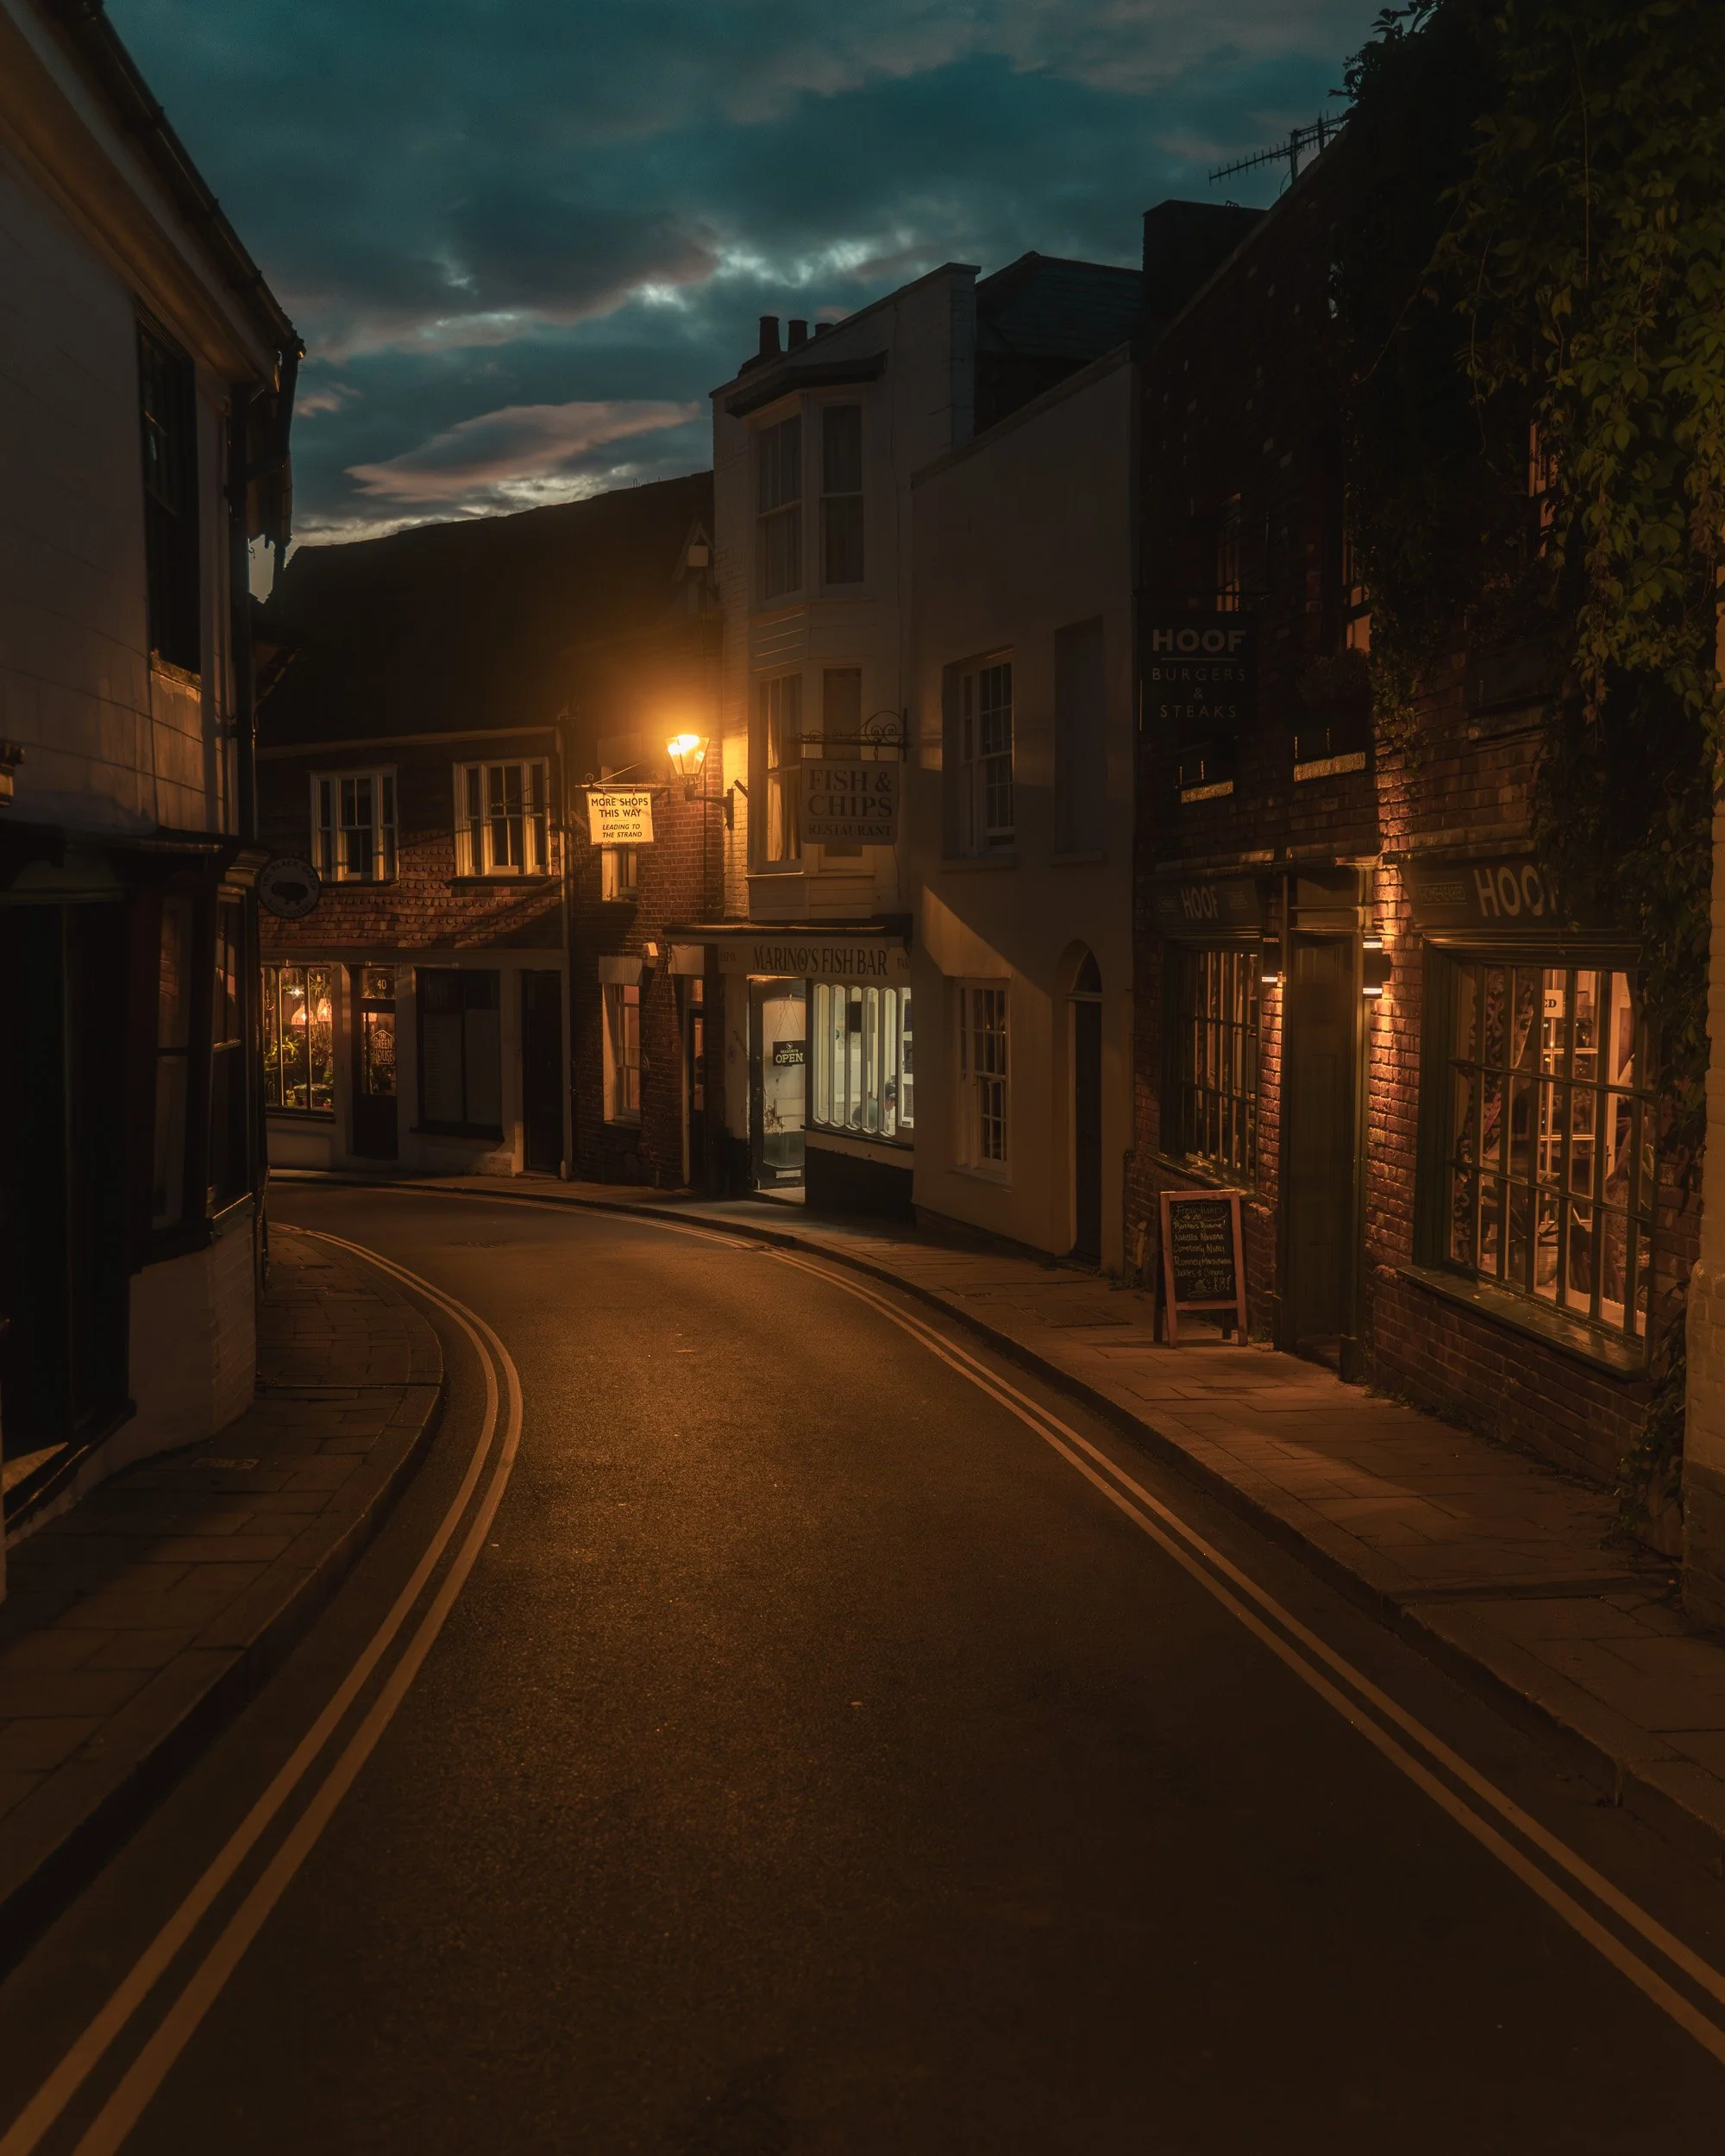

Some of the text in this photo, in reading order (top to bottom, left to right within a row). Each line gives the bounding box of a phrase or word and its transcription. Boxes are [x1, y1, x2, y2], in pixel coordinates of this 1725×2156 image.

[1152, 628, 1247, 653] HOOF
[1152, 667, 1247, 681] BURGERS
[1193, 686, 1204, 700] &
[1159, 704, 1237, 718] STEAKS
[807, 769, 894, 793] FISH &
[591, 798, 649, 806] MORE SHOPS
[807, 794, 893, 818] CHIPS
[599, 809, 641, 818] THIS WAY
[807, 824, 893, 837] RESTAURANT
[1180, 885, 1219, 919] HOOF
[753, 944, 819, 973] MARINO'S
[822, 947, 854, 975] FISH
[857, 949, 888, 976] BAR
[377, 979, 387, 990] 40
[373, 1037, 393, 1050] GREEN
[373, 1049, 395, 1062] HOUSE
[775, 1052, 804, 1063] OPEN
